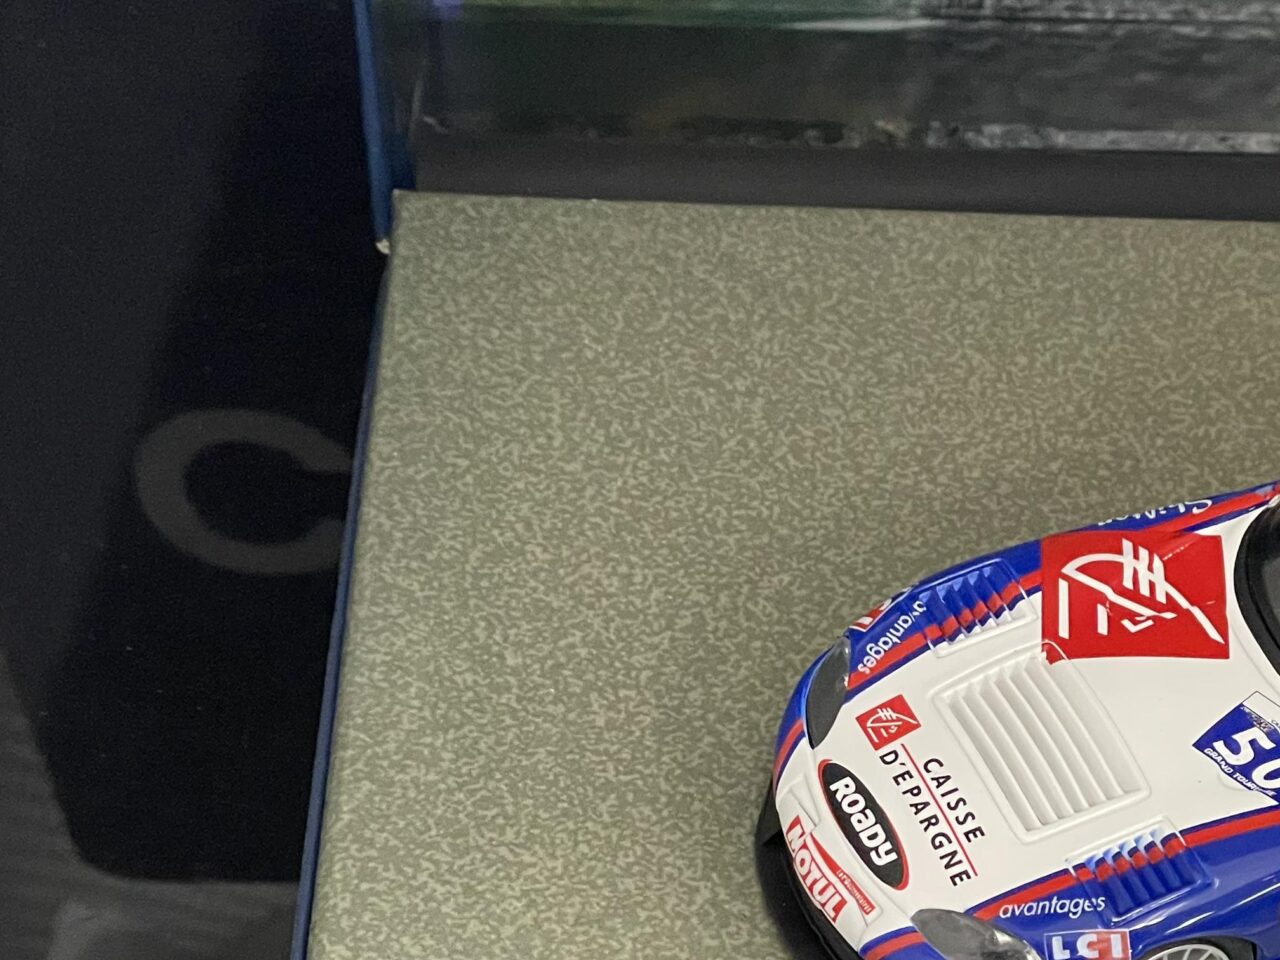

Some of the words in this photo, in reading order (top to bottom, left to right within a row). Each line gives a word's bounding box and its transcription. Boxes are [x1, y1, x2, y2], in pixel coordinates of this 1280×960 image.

[857, 600, 927, 675] avantages
[1203, 747, 1234, 774] GRAND
[923, 758, 986, 843] CAISSE
[785, 820, 848, 921] MOTUL
[999, 896, 1106, 919] avantages
[1052, 933, 1124, 960] LCI
